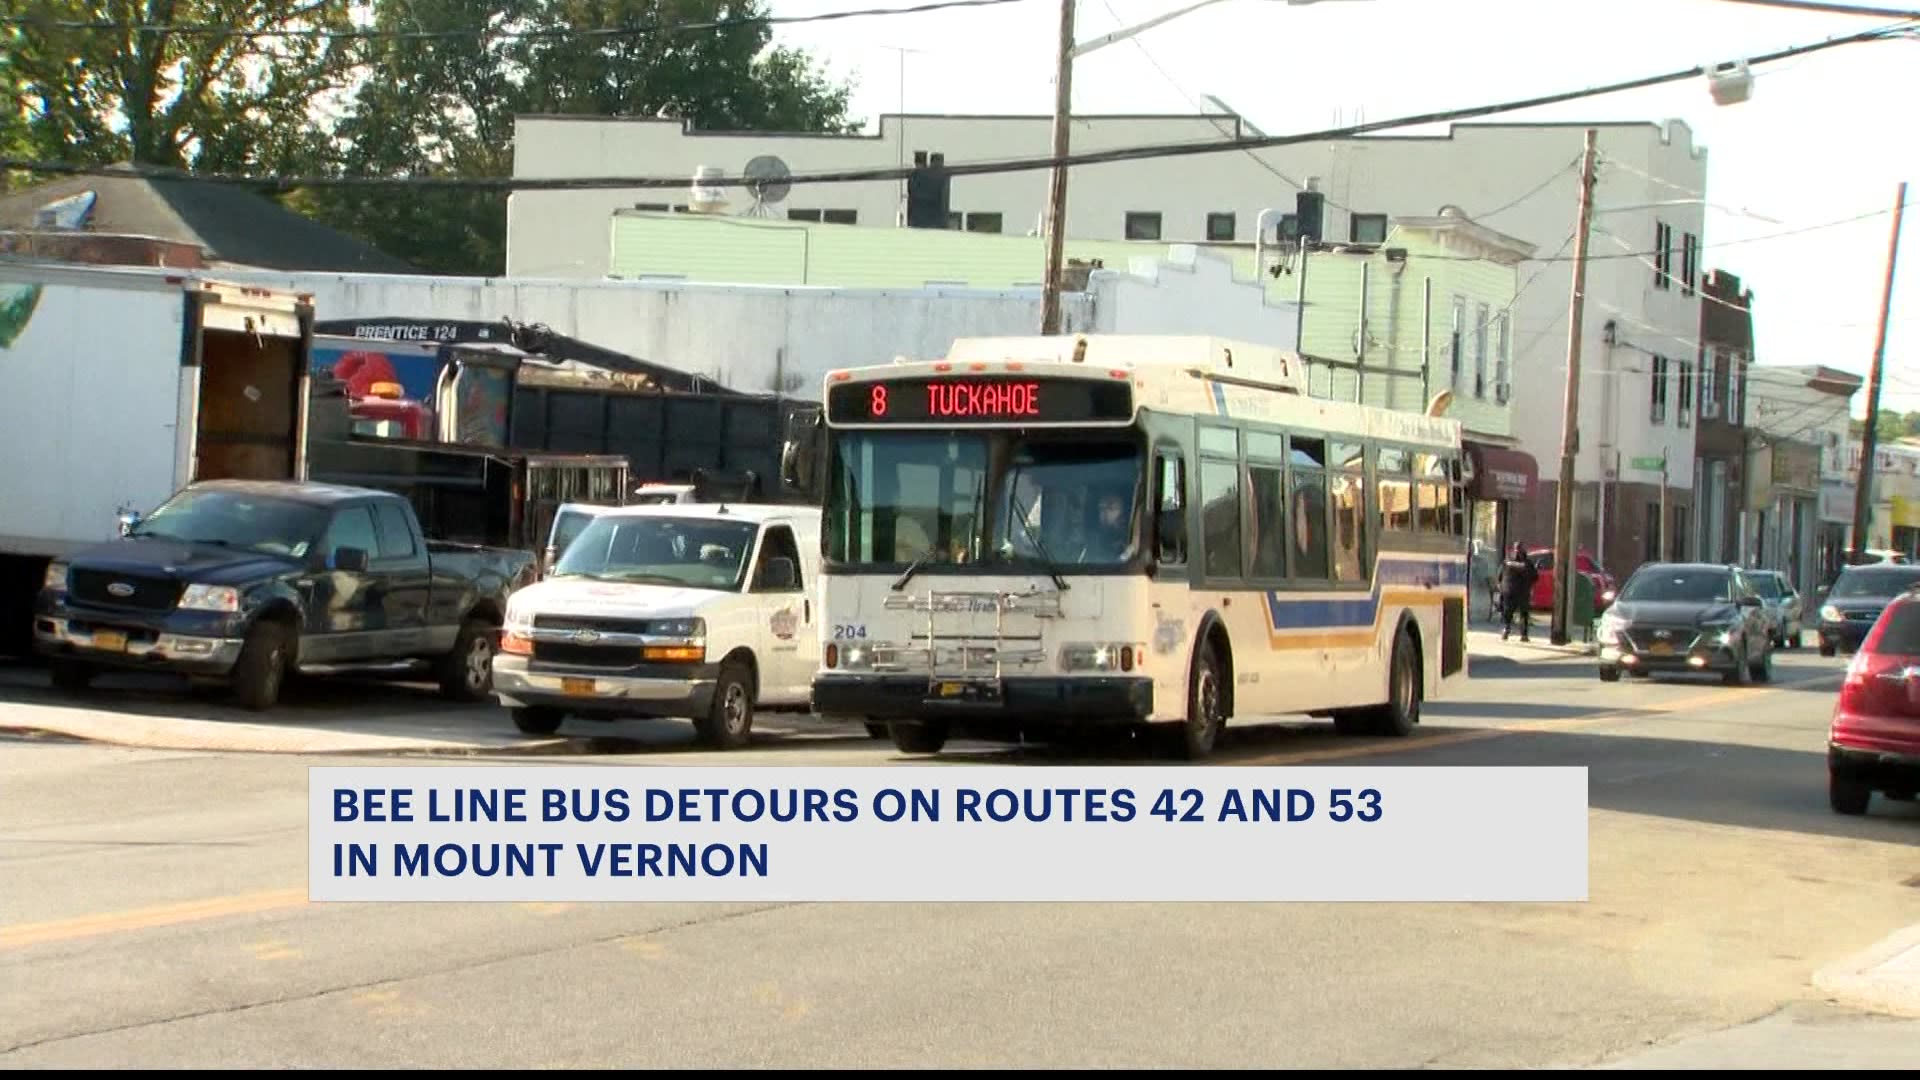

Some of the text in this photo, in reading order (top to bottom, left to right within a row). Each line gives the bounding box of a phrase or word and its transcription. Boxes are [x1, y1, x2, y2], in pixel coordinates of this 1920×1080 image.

[355, 325, 457, 340] PRENTICE 124
[871, 383, 1039, 416] 8 TUCKAHOE
[834, 624, 866, 639] 204
